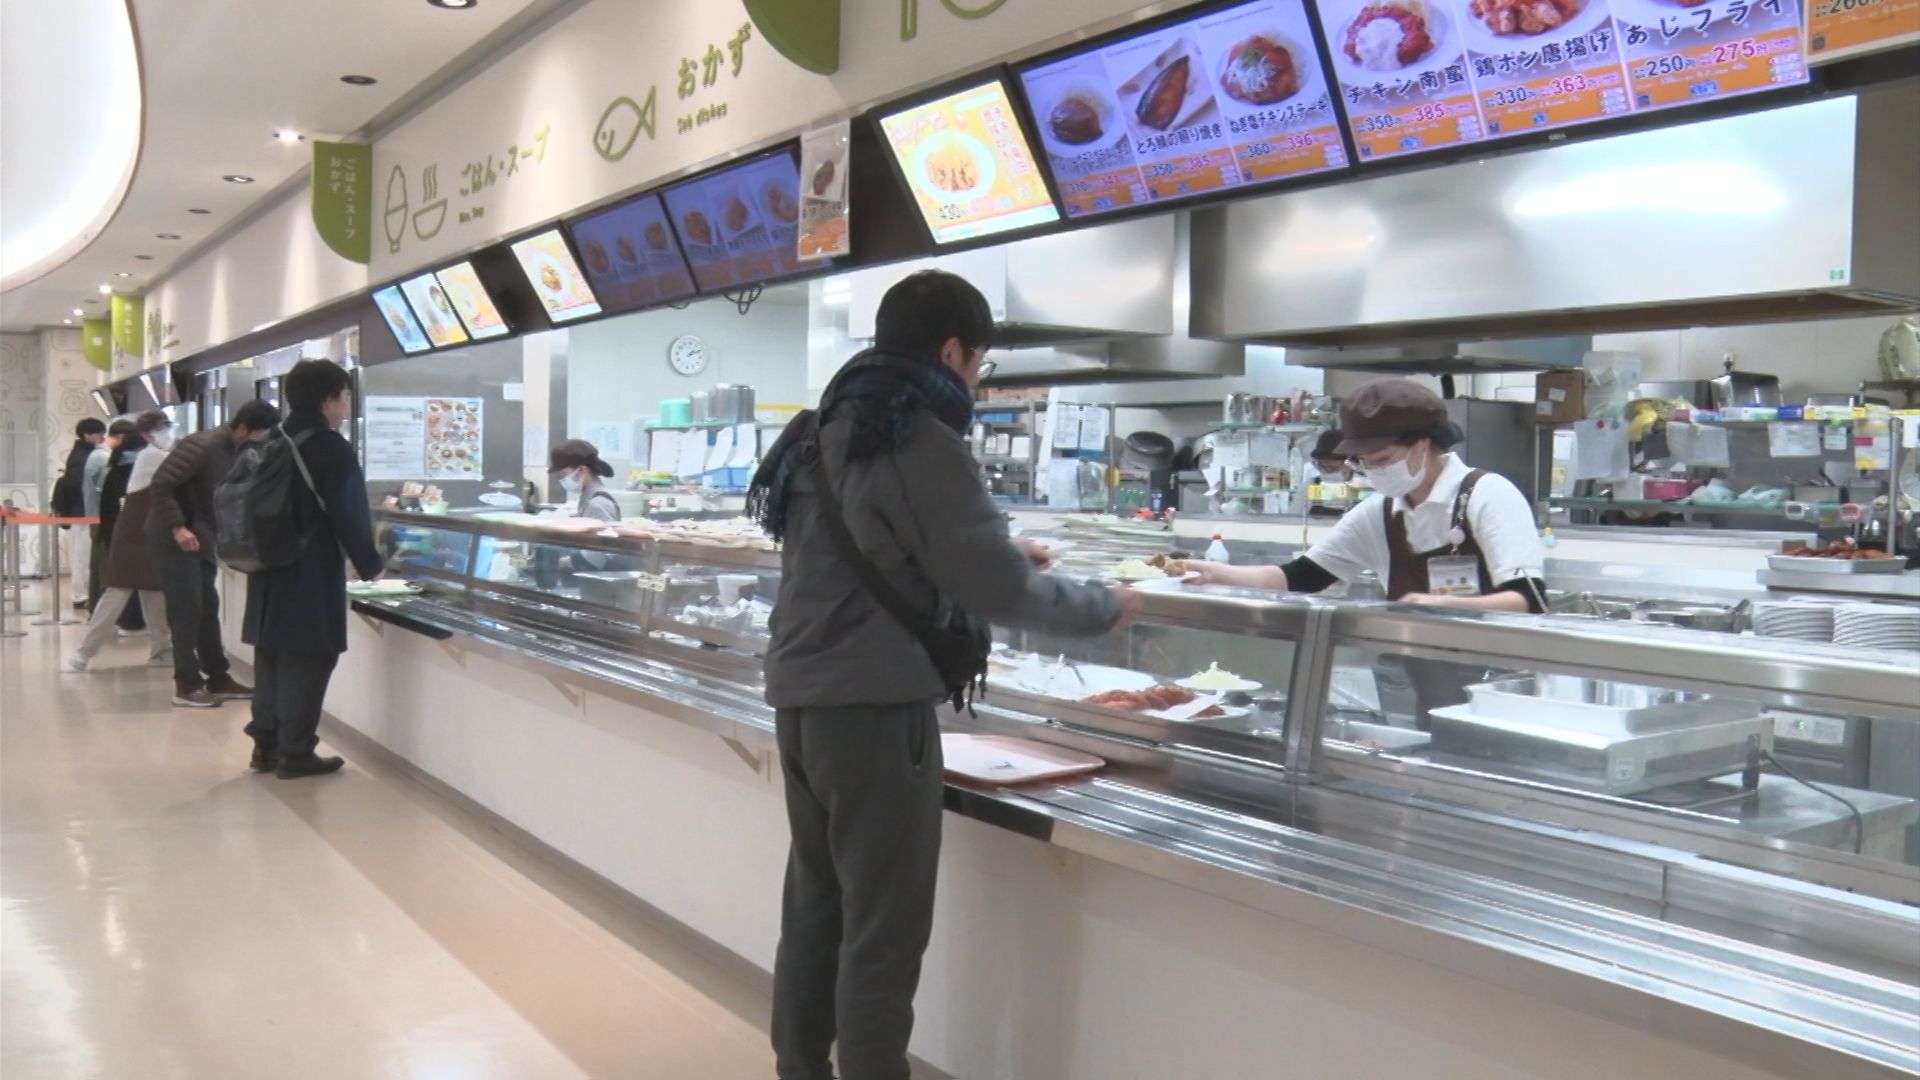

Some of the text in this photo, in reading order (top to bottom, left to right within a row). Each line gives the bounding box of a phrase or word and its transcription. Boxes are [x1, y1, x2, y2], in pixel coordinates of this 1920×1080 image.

[1627, 0, 1781, 46] あじフライ
[677, 22, 751, 100] おかず
